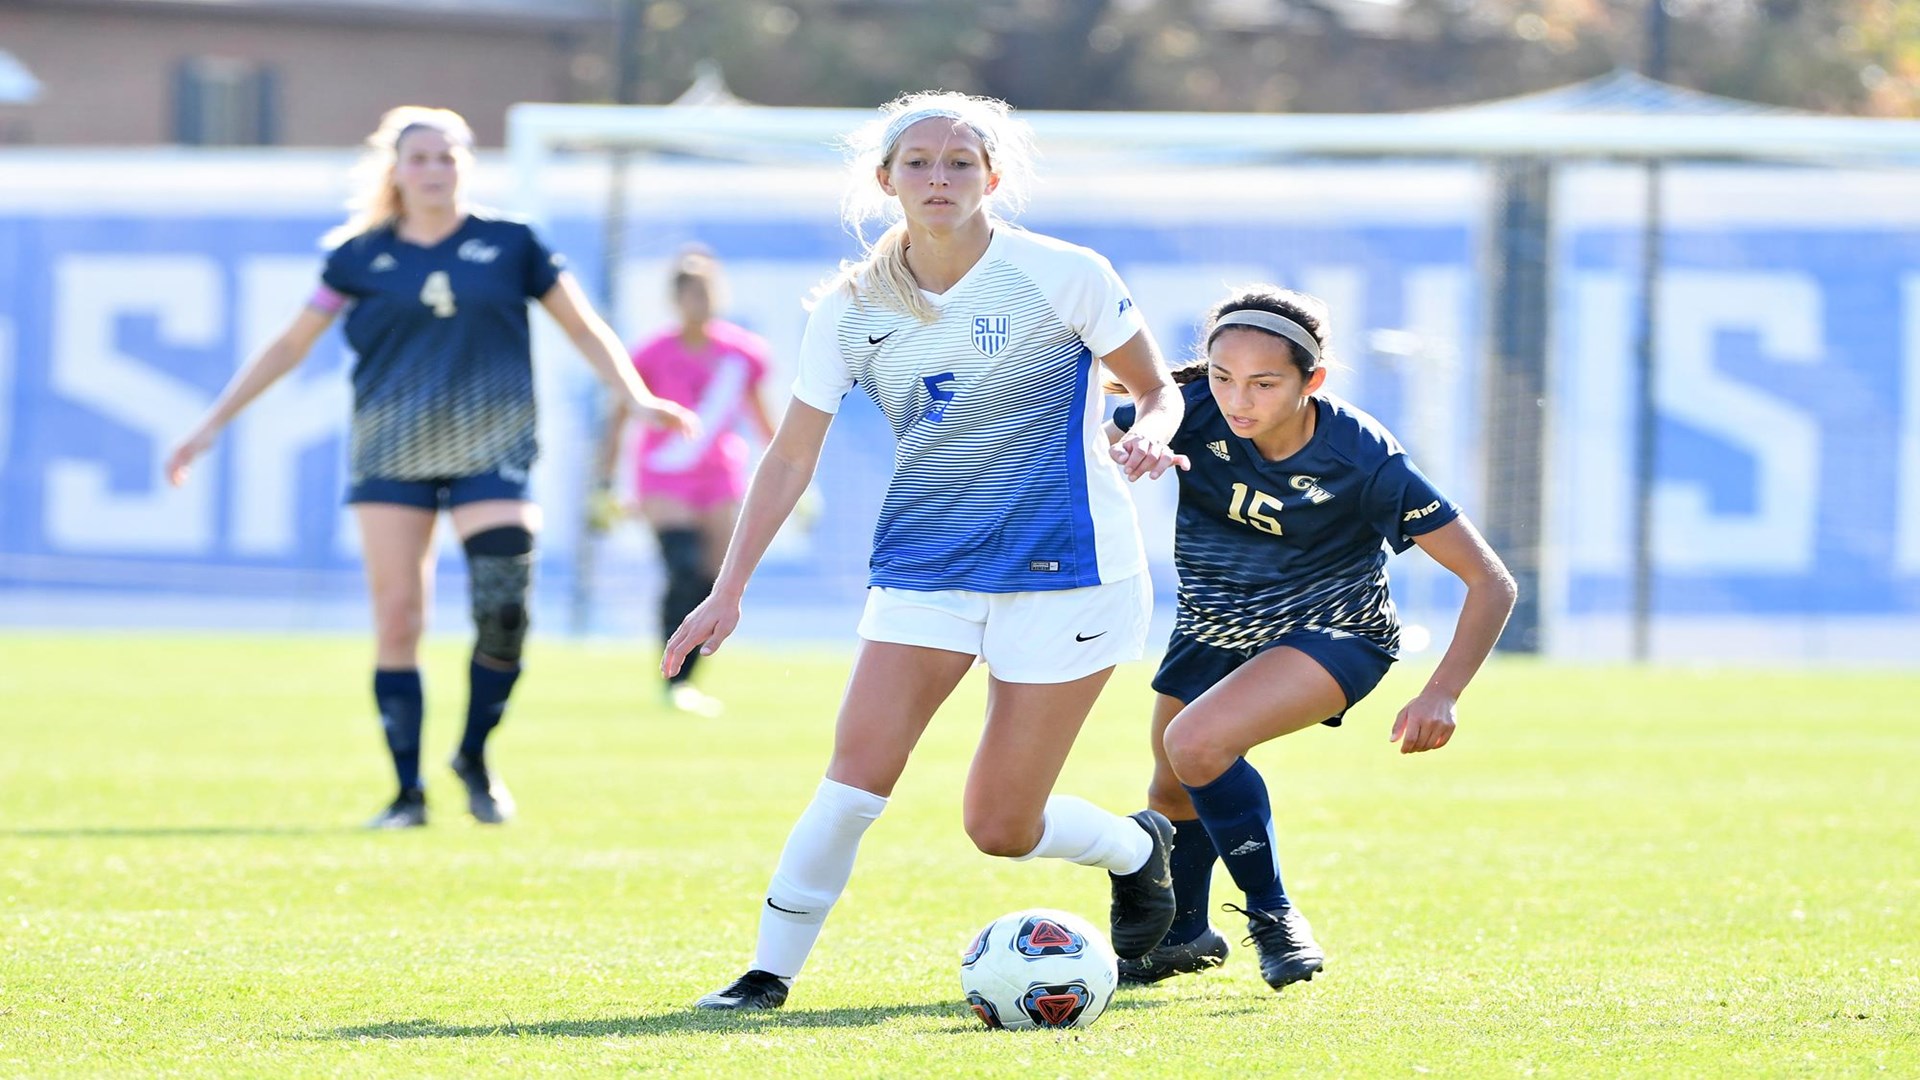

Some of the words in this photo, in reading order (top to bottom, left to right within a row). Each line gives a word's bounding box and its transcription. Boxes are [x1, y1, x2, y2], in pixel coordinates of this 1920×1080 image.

[420, 269, 456, 318] 4
[975, 317, 1007, 335] SLU
[922, 371, 956, 423] 5
[1206, 442, 1231, 461] adidas
[1288, 474, 1336, 506] GW
[1227, 482, 1284, 536] 15
[1403, 499, 1441, 521] A10
